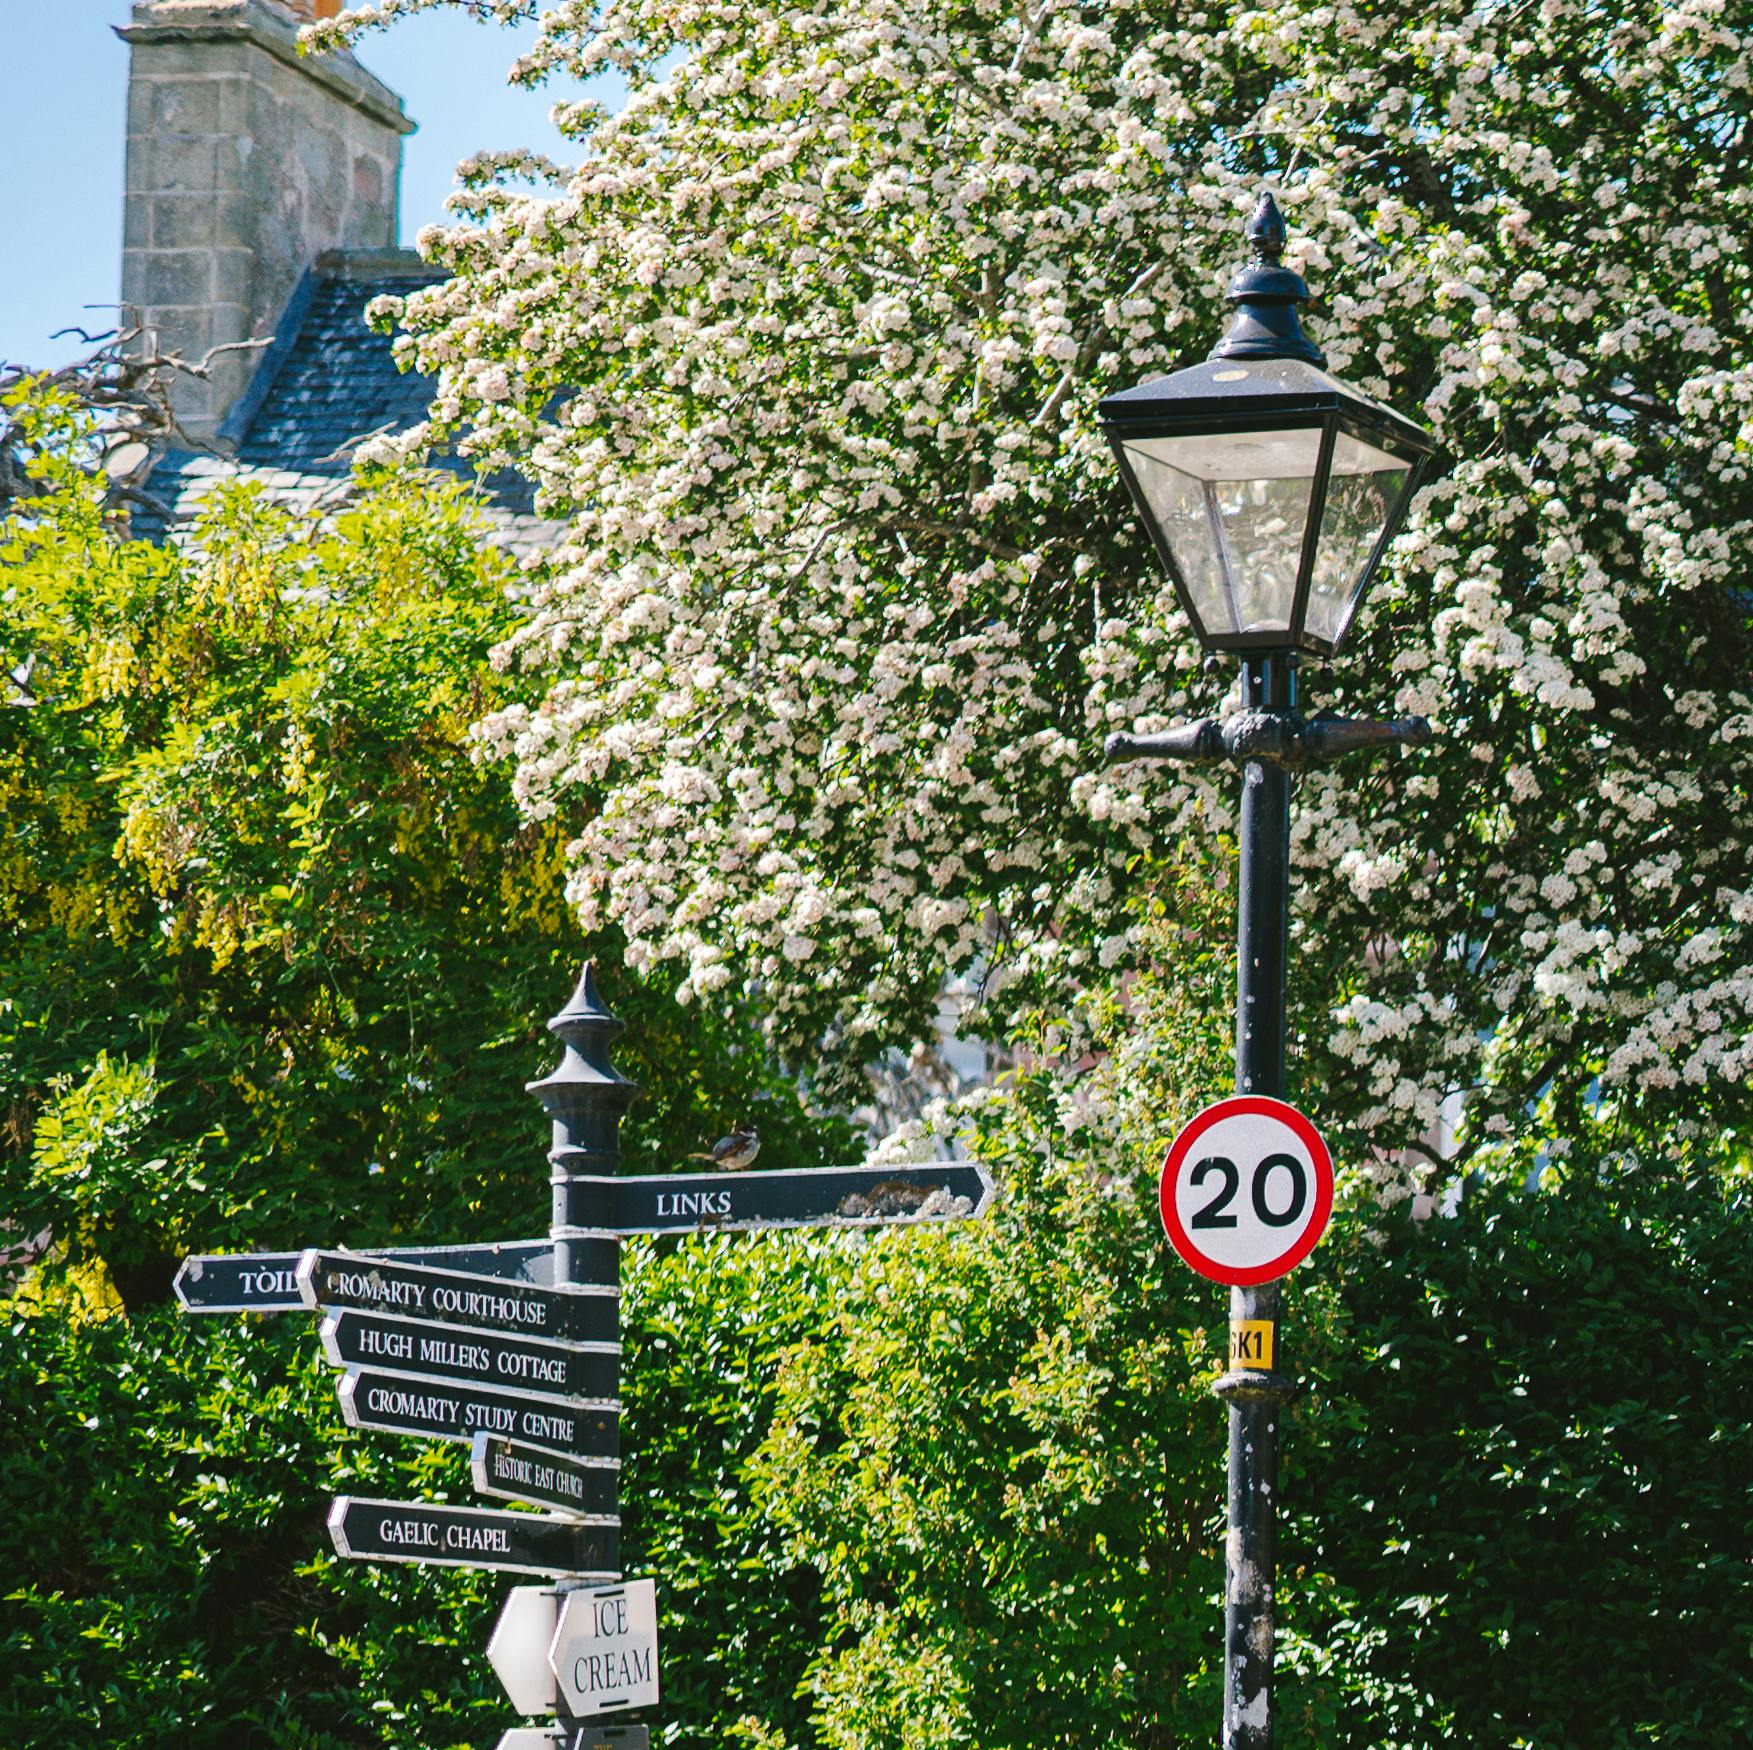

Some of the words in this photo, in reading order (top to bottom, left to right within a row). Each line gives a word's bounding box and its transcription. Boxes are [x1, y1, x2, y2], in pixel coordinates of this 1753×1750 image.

[656, 1191, 732, 1217] LINKS
[1189, 1153, 1307, 1229] 20
[327, 1272, 426, 1308] CROMARTY
[432, 1287, 546, 1326] COURTHOUSE
[359, 1328, 412, 1360] HUGH
[420, 1338, 490, 1371] MILLER'S
[497, 1351, 566, 1384] COTTAGE
[368, 1388, 460, 1424] CROMARTY
[465, 1403, 518, 1432] STUDY
[522, 1412, 575, 1443] CENTRE
[494, 1454, 533, 1486] HISTORIC
[534, 1464, 555, 1491] EAST
[556, 1475, 584, 1499] CHURCH
[380, 1519, 439, 1546] GAELIC
[447, 1524, 511, 1553] CHAPEL
[593, 1598, 630, 1638] ICE
[574, 1647, 652, 1694] CREAM
